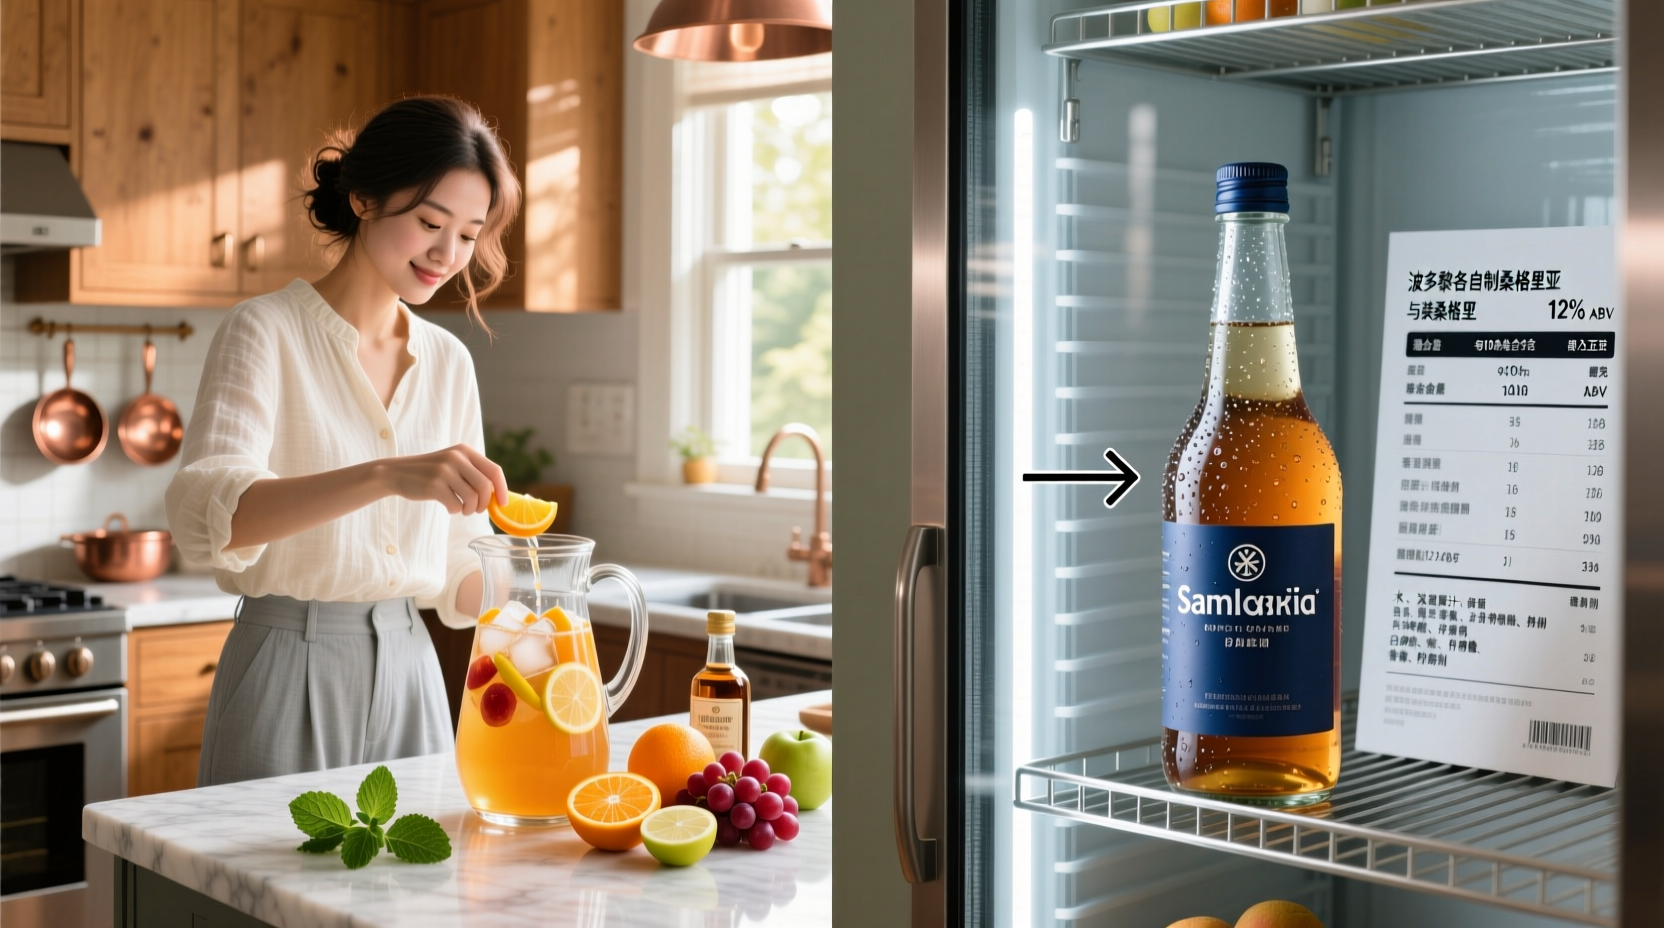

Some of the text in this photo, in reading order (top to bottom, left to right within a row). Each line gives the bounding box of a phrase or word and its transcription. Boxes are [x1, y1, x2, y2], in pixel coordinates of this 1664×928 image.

[1408, 270, 1561, 292] 波多黎各自制桑格里亚
[1548, 299, 1615, 320] 12% ABV
